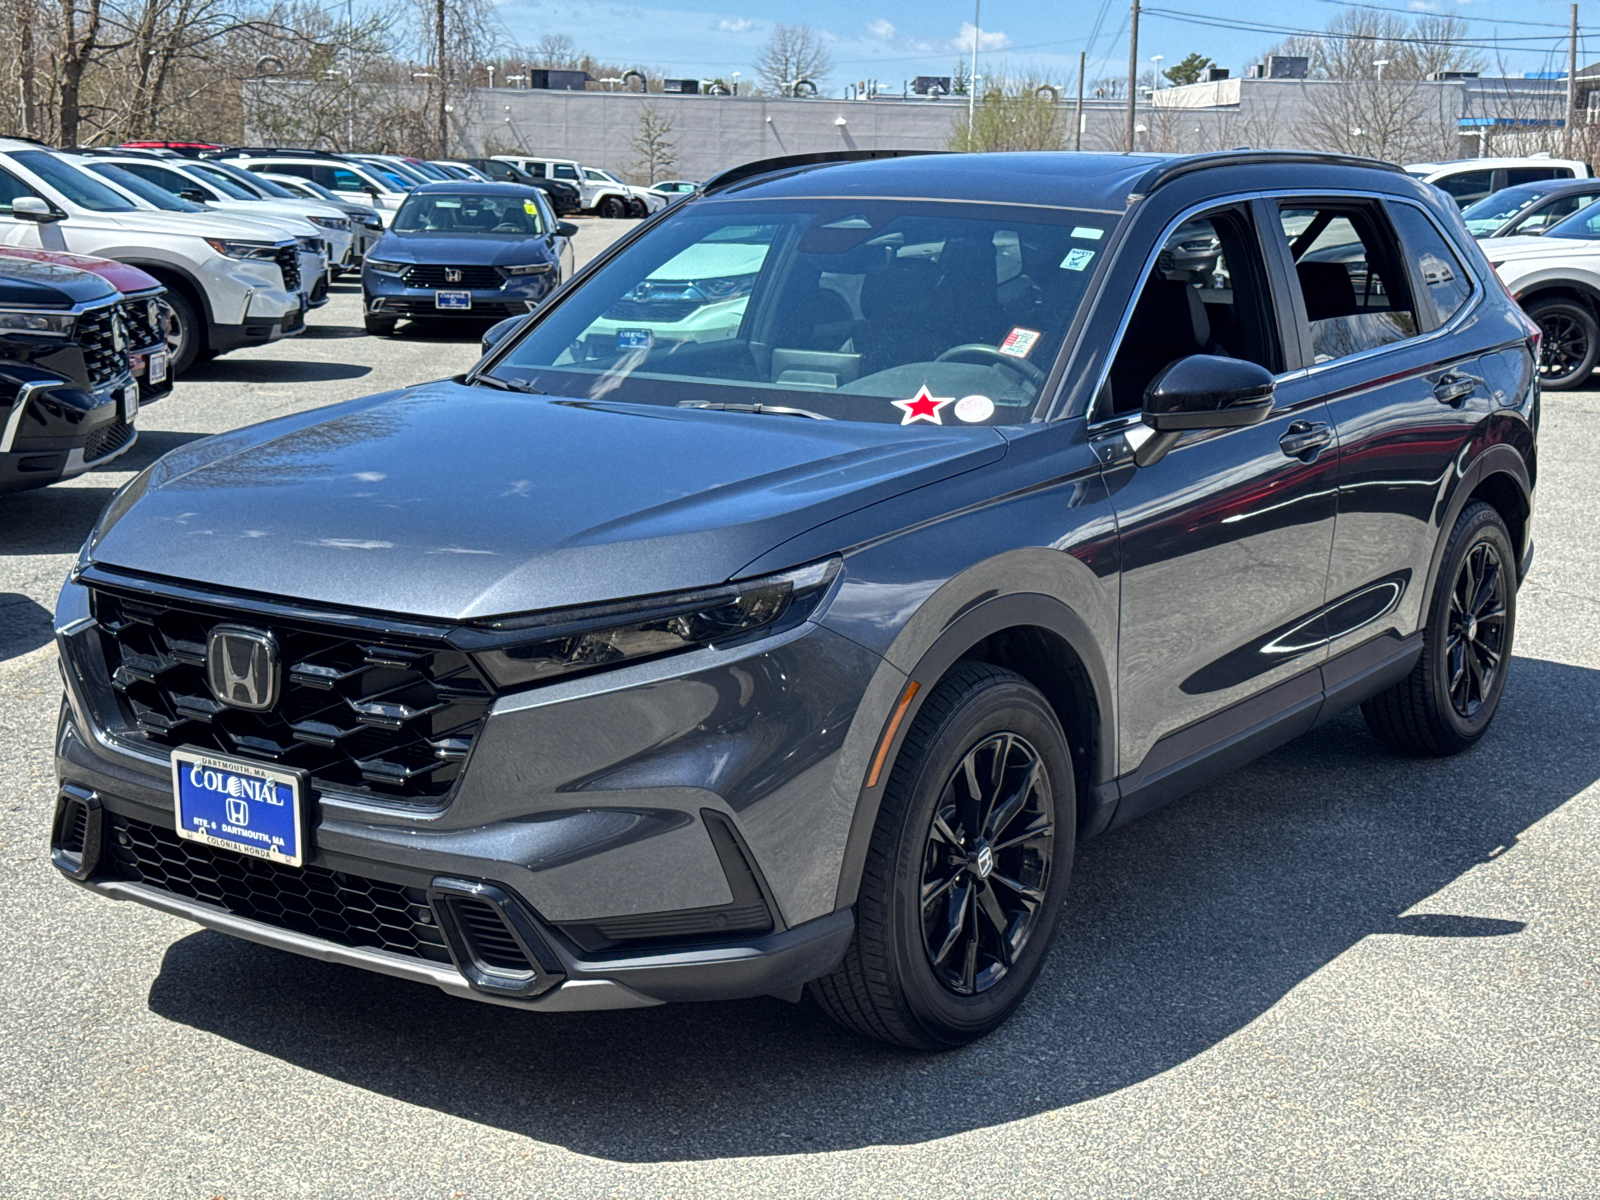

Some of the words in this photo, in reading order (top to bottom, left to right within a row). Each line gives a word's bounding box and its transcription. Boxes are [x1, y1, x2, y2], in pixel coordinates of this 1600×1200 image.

[201, 757, 252, 774] DARTMOUTH,
[254, 769, 266, 777] MA
[190, 767, 284, 807] COLONIAL
[193, 816, 210, 828] RTE.
[211, 822, 217, 830] 6
[221, 823, 271, 844] DARTMOUTH,
[272, 835, 285, 846] MA
[206, 836, 242, 852] COLONIAL
[244, 847, 271, 859] HONDA
